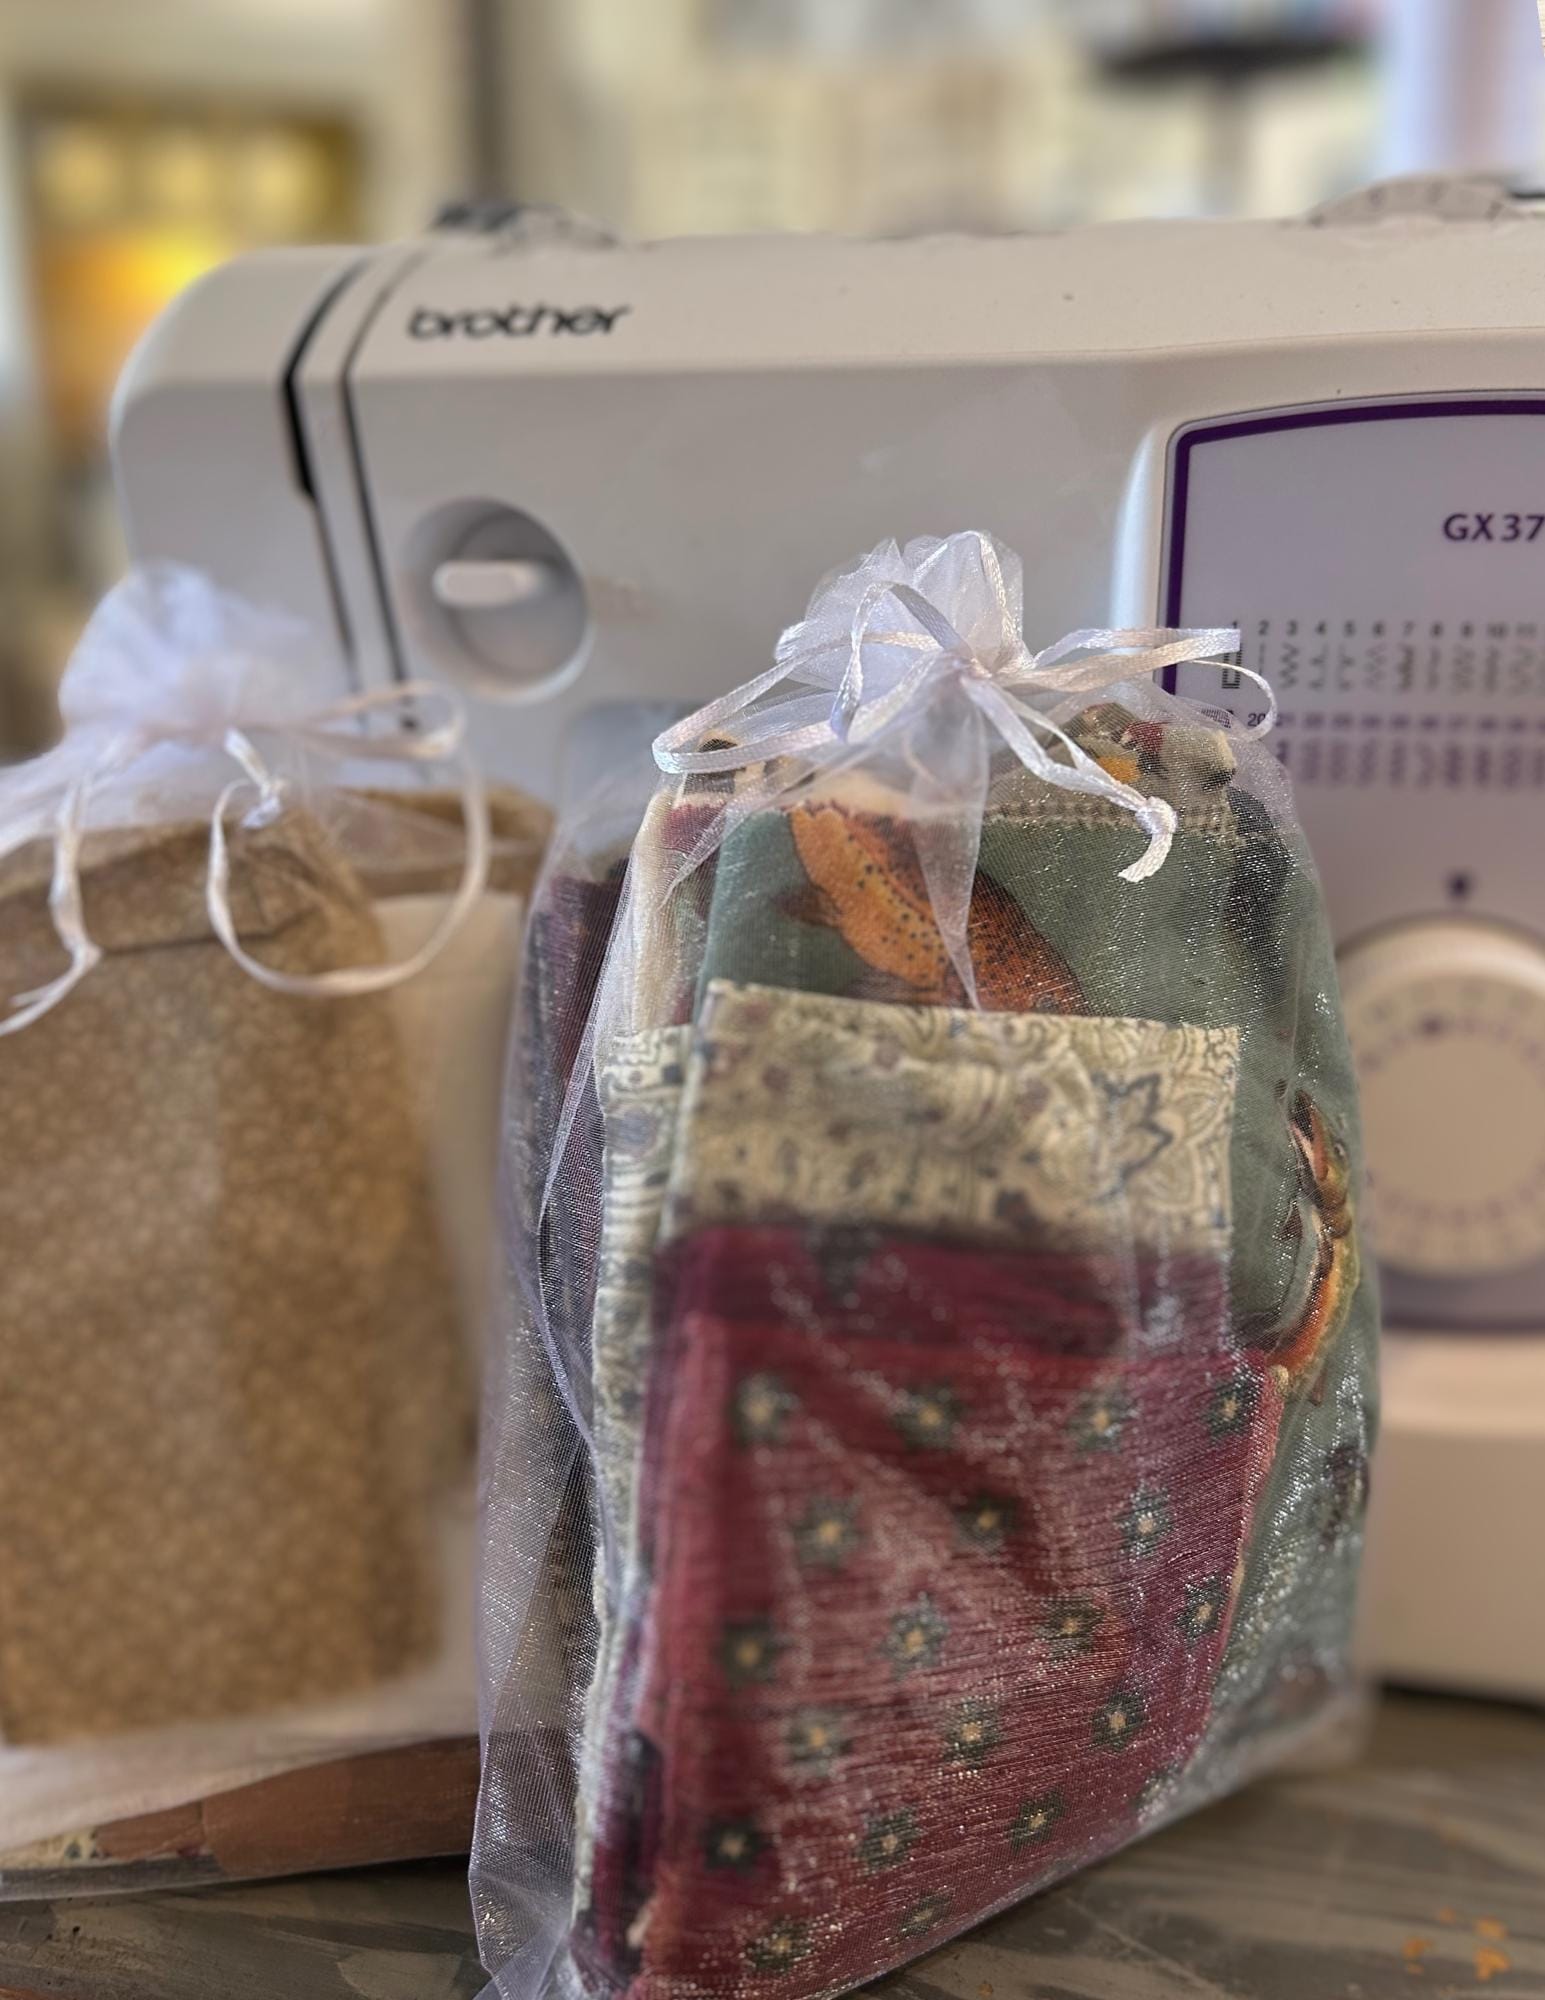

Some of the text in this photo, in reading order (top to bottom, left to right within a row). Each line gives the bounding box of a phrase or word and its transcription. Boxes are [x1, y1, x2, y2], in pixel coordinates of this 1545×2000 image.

[406, 302, 632, 341] brother
[1259, 620, 1269, 636] 2
[1288, 620, 1298, 636] 3
[1315, 620, 1326, 636] 4
